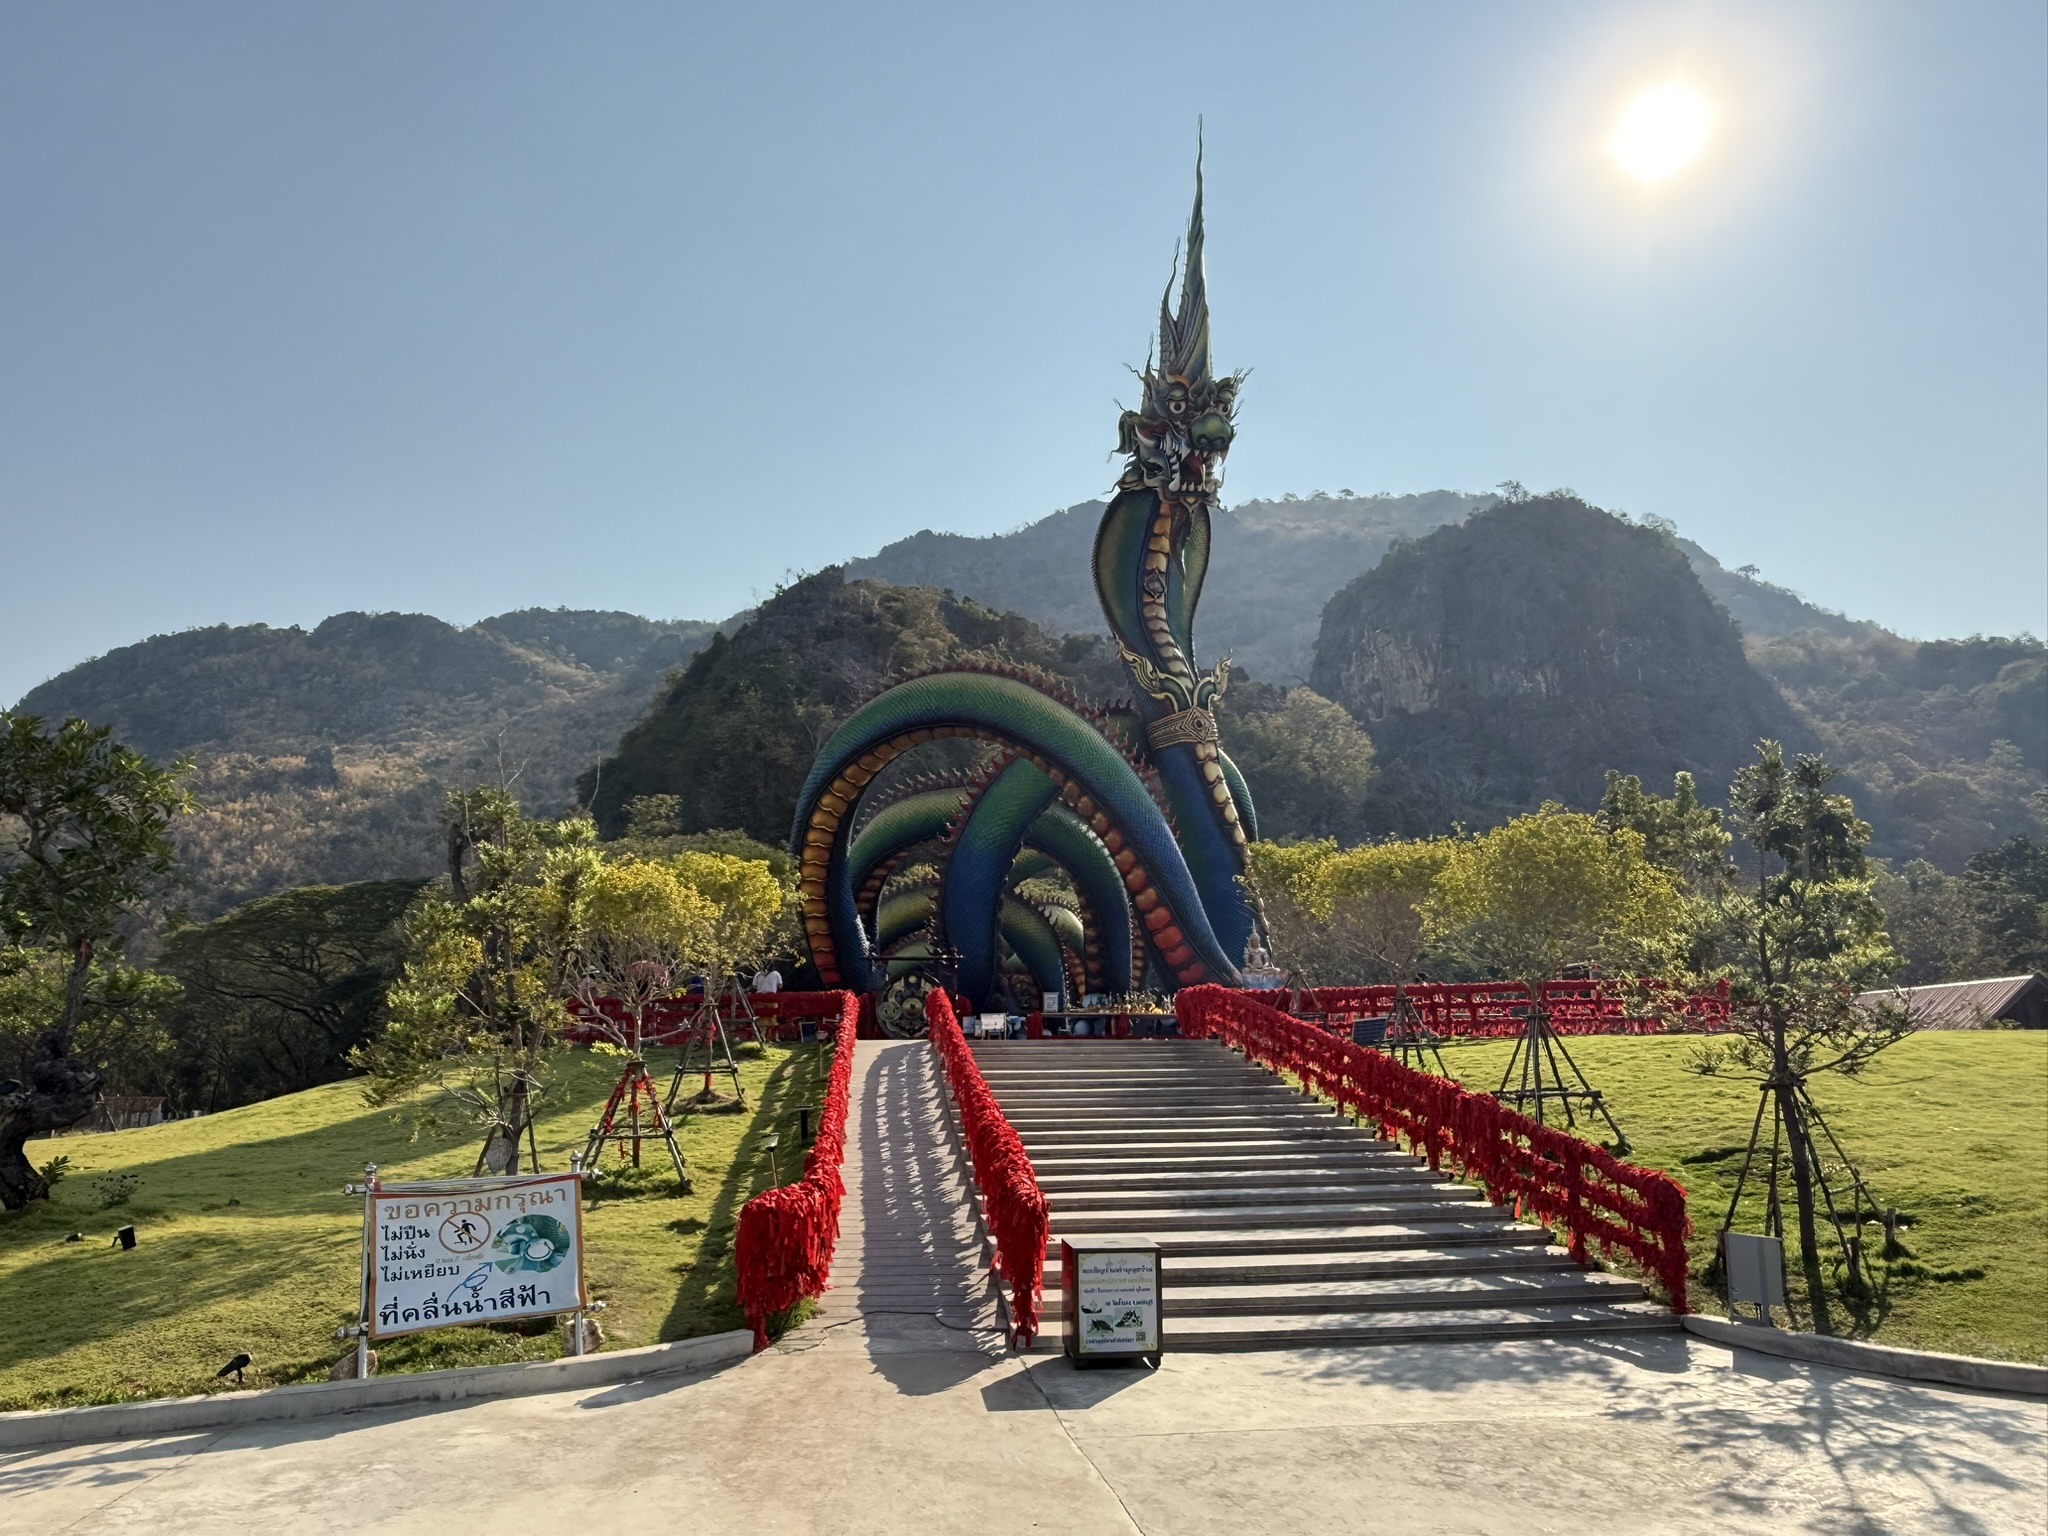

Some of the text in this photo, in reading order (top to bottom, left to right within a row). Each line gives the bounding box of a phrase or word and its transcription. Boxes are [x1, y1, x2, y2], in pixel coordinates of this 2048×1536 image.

[383, 1188, 567, 1220] ขอความกรุณา
[380, 1241, 426, 1262] ไม่นั่ง
[380, 1263, 460, 1283] ไม่เหยียบ
[378, 1284, 552, 1326] ที่คลื่นน้ำสีฟ้า
